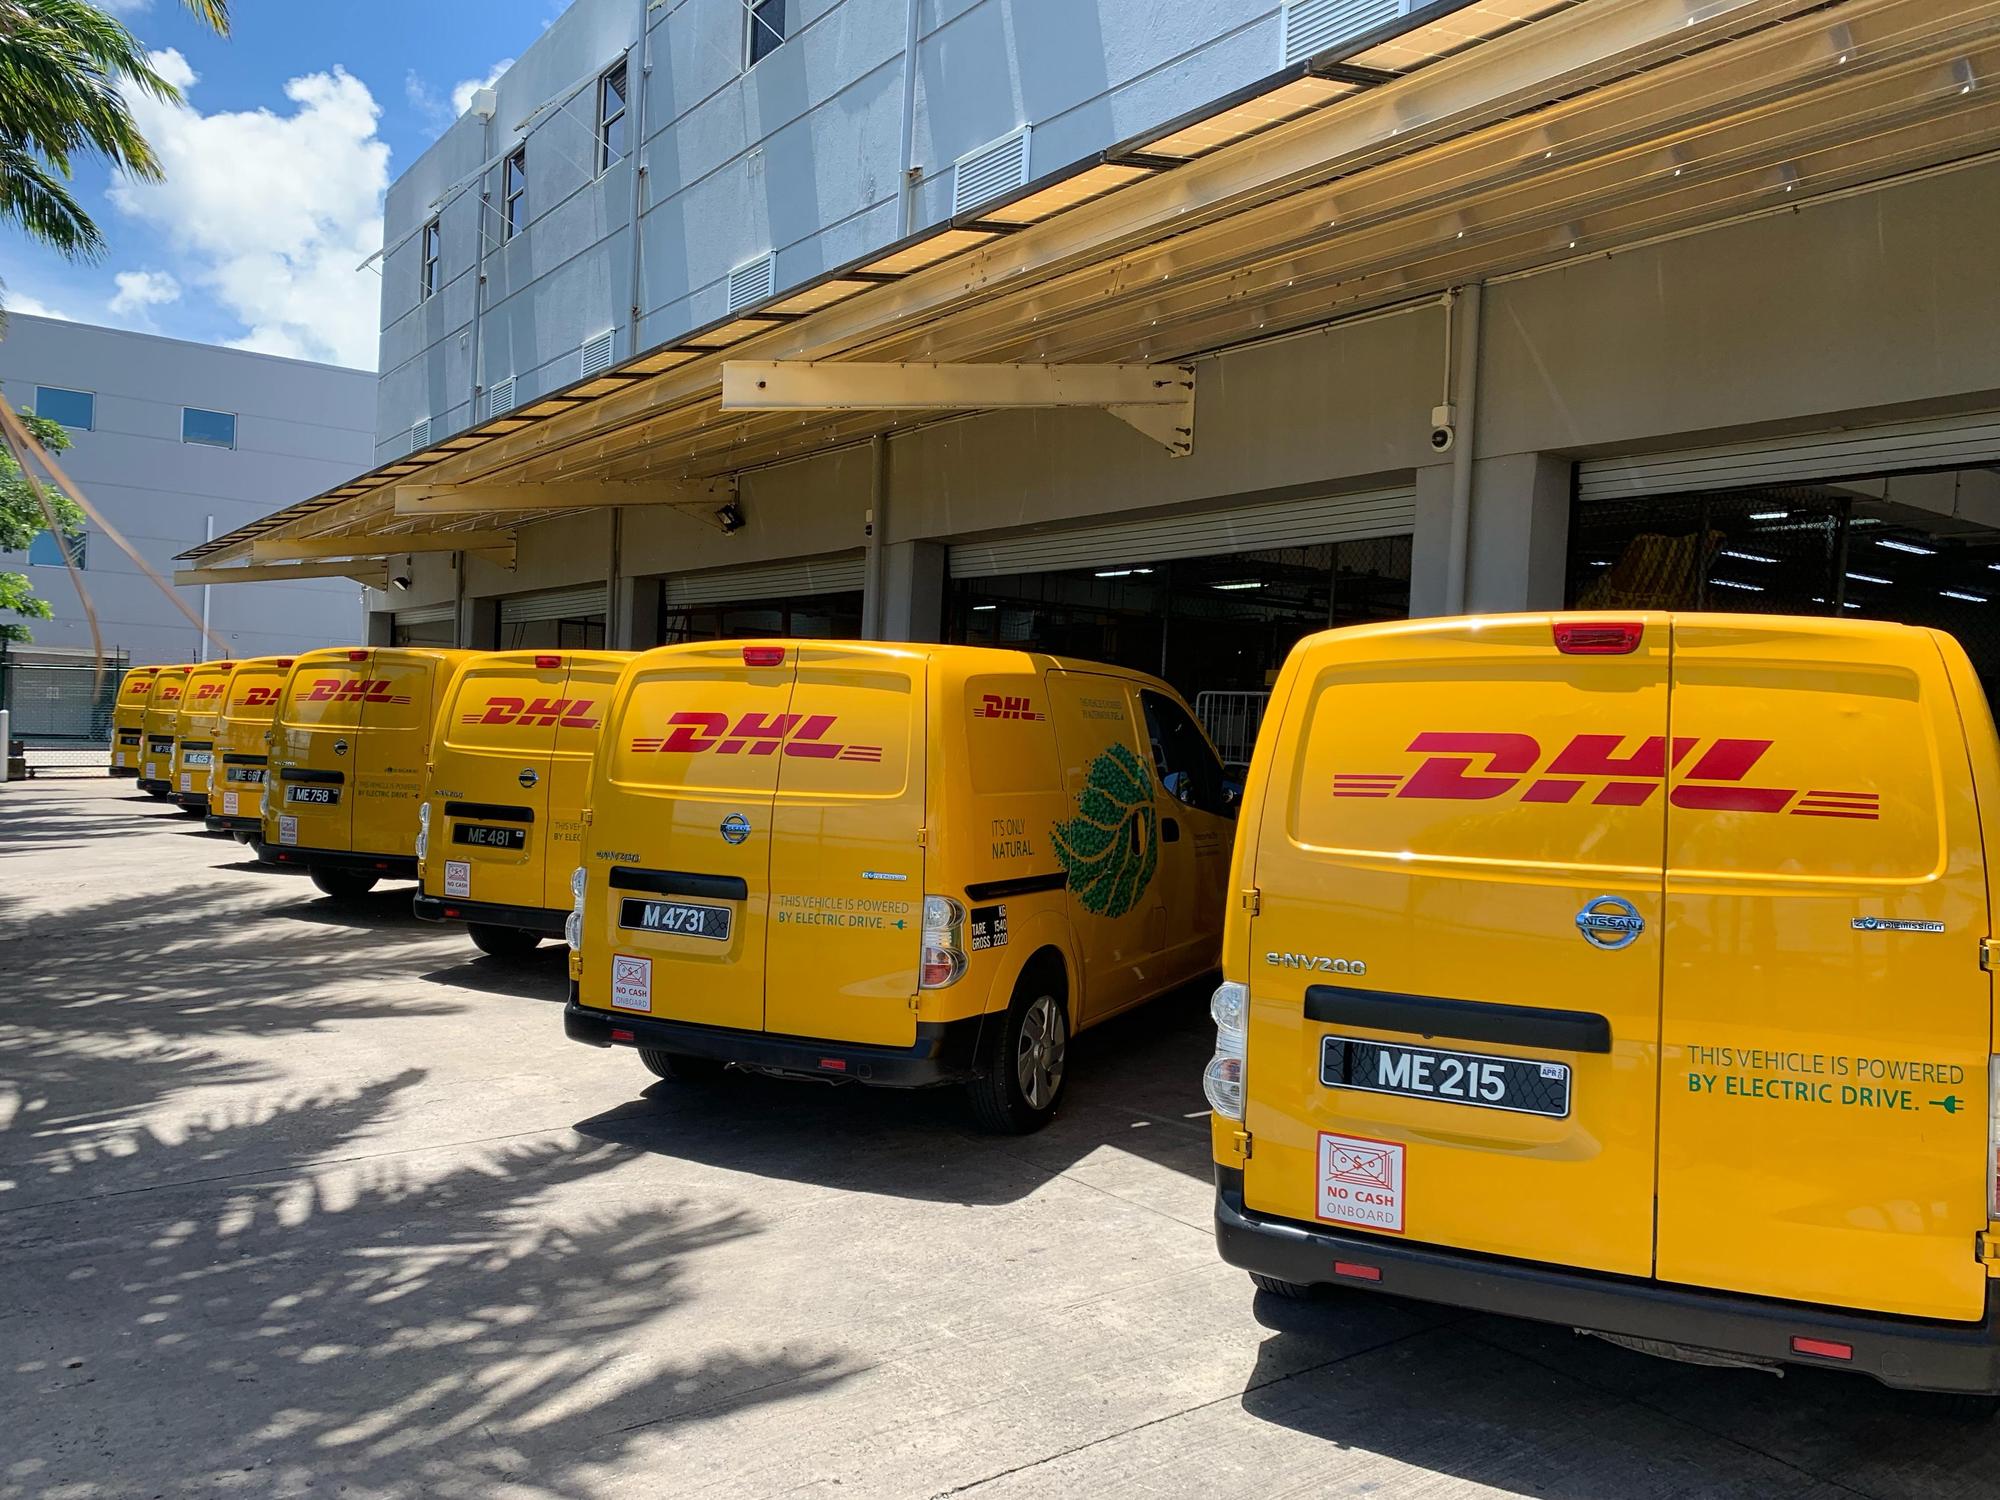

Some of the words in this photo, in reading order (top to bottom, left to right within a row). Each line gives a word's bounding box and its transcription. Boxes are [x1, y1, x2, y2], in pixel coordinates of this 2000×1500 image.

[307, 679, 393, 703] DHL
[480, 696, 599, 729] DHL
[983, 694, 1036, 720] DHL
[660, 712, 845, 759] DHL
[1396, 732, 1799, 814] DHL
[467, 827, 487, 844] ME
[487, 830, 510, 846] 481
[1006, 818, 1025, 836] ONLY
[780, 895, 801, 908] THIS
[802, 896, 842, 910] VEHICLE
[844, 898, 854, 911] IS
[857, 899, 909, 914] POWERED
[643, 904, 661, 927] M
[662, 907, 705, 933] 4731
[778, 911, 793, 923] BY
[795, 912, 845, 927] ELECTRIC
[848, 915, 886, 929] DRIVE.
[971, 921, 987, 936] TARE
[1583, 917, 1637, 929] NISSAN
[972, 935, 991, 950] GROSS
[993, 932, 1008, 946] 2220
[615, 986, 626, 995] NO
[628, 988, 647, 998] CASH
[1687, 1045, 1733, 1067] THIS
[1736, 1049, 1825, 1075] VEHICLE
[1831, 1056, 1849, 1076] IS
[1856, 1058, 1965, 1085] POWERED
[1688, 1072, 1717, 1093] BY
[1725, 1075, 1833, 1105] ELECTRIC
[1841, 1085, 1920, 1112] DRIVE.
[1327, 1185, 1348, 1199] NO
[1355, 1191, 1394, 1207] CASH
[1326, 1202, 1394, 1224] ONBOARD
